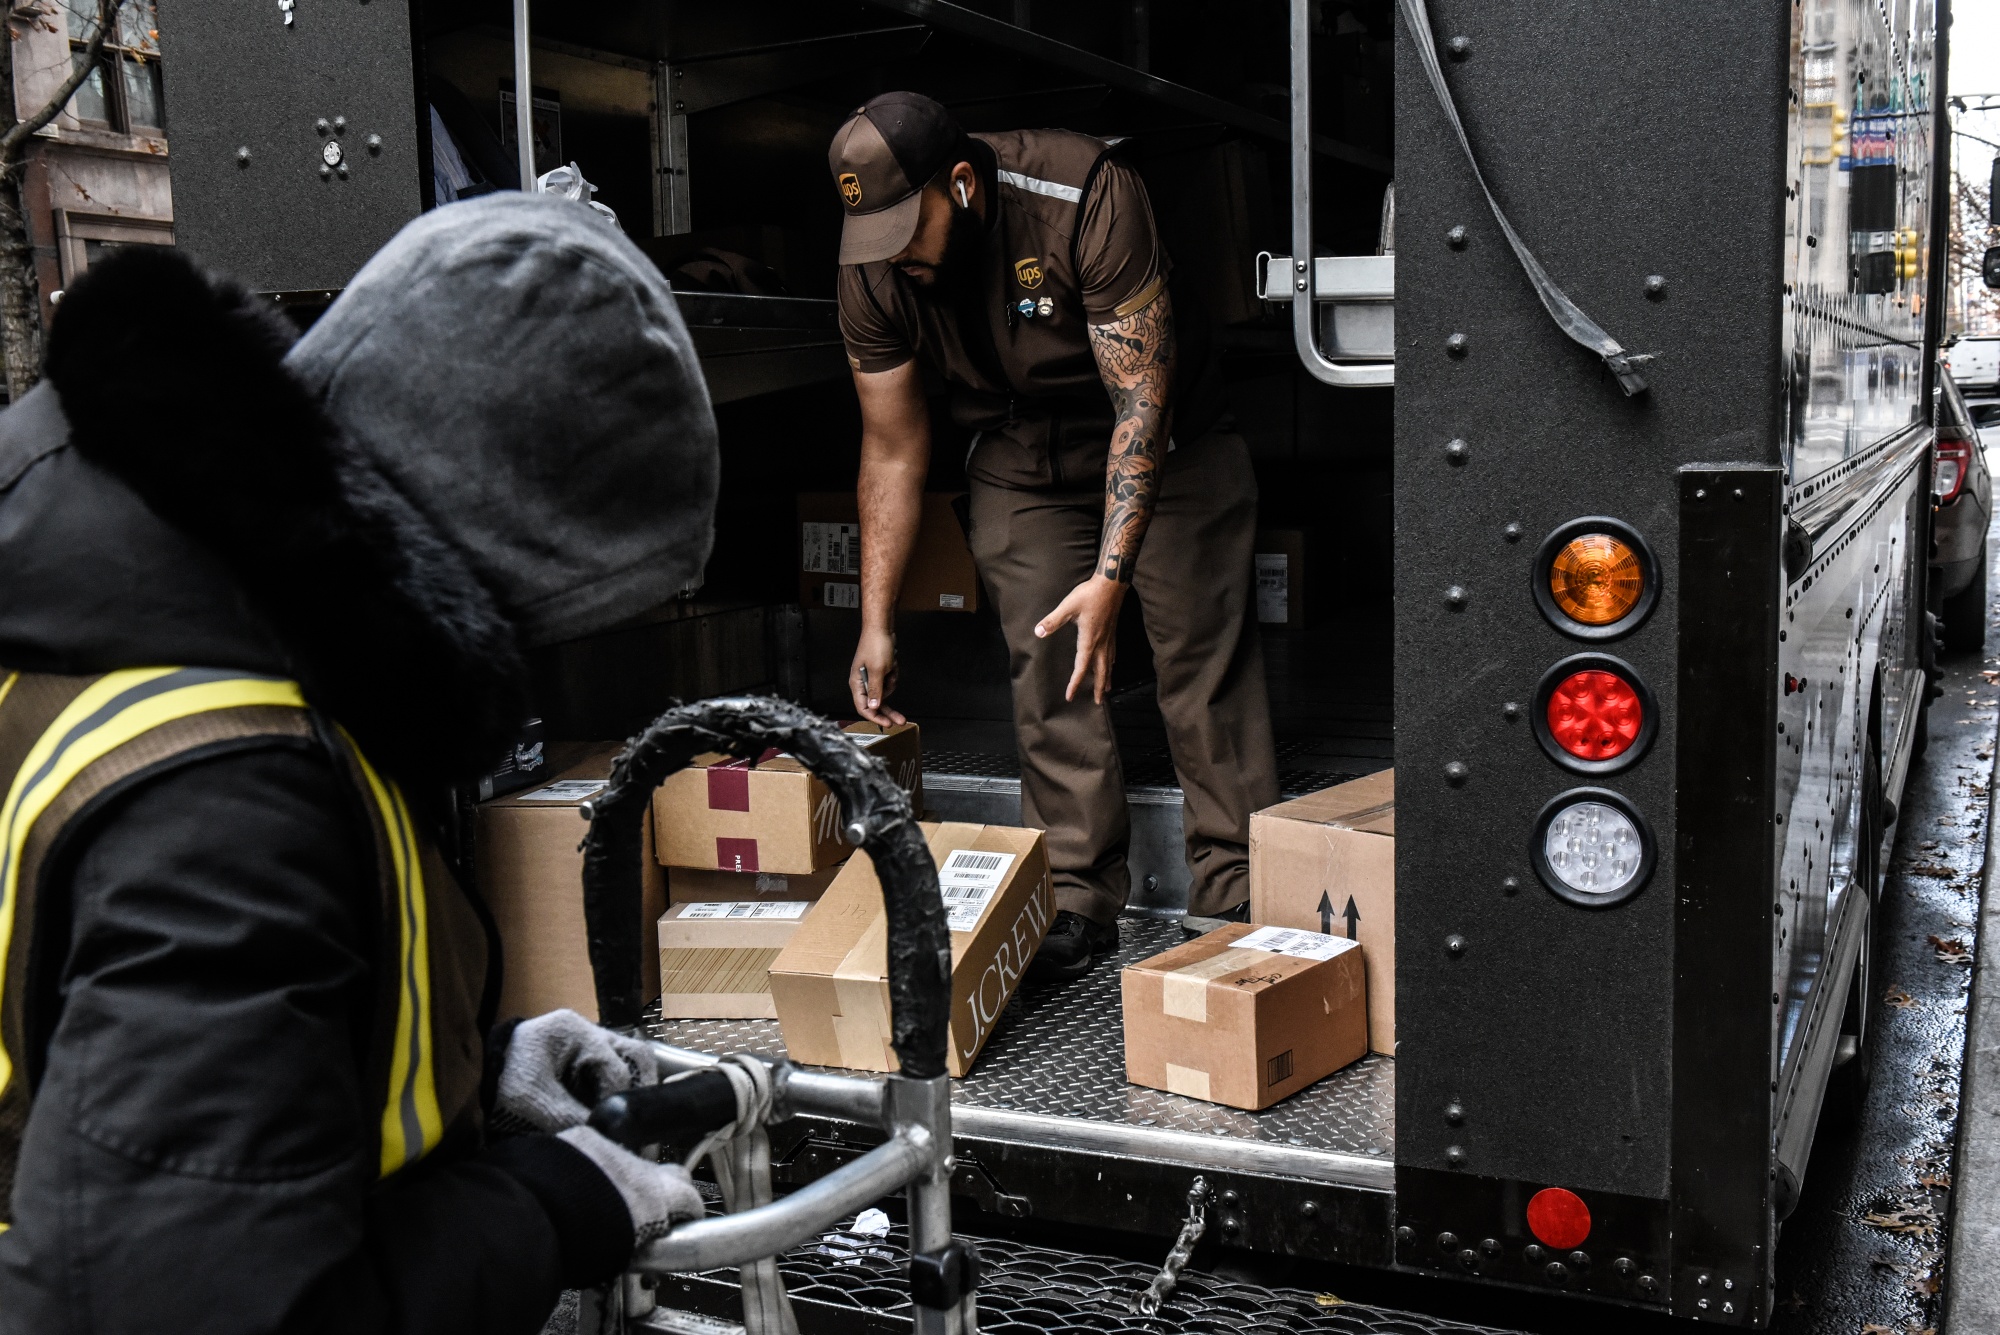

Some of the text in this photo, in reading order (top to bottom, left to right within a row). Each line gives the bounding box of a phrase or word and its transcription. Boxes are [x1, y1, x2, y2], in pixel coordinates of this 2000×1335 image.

[843, 182, 859, 201] ups
[1018, 266, 1041, 285] ups
[963, 872, 1048, 1059] J.CREW
